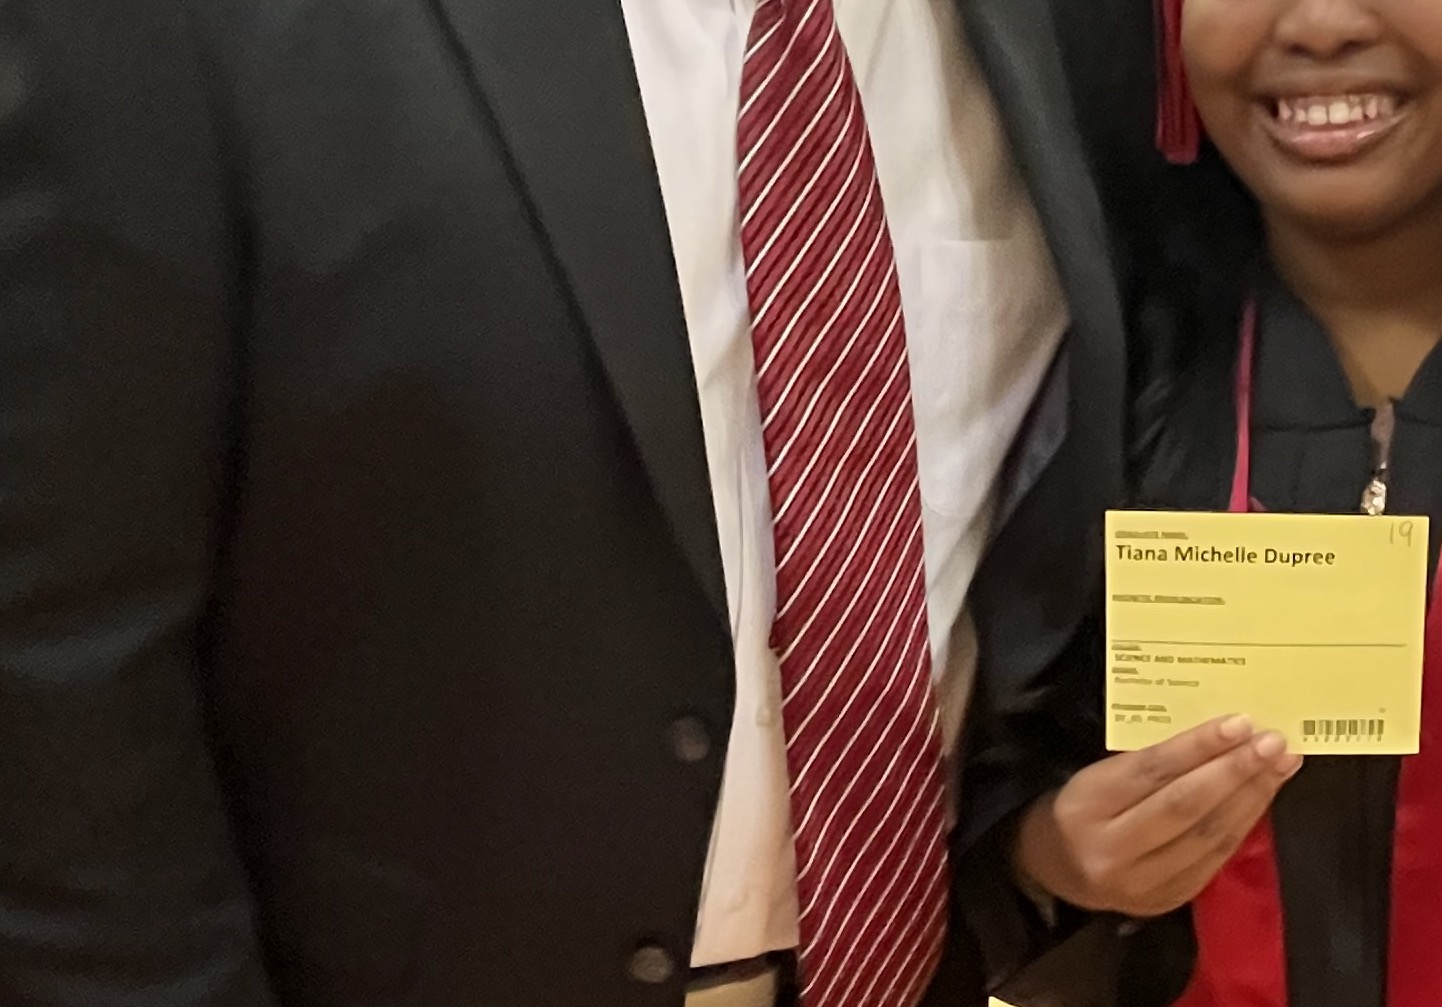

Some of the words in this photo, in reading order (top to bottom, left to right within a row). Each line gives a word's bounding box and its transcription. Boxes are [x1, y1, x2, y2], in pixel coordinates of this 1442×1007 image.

[1389, 520, 1414, 547] 19
[1115, 544, 1168, 562] Tiana
[1174, 545, 1258, 564] Michelle
[1264, 548, 1336, 568] Dupree
